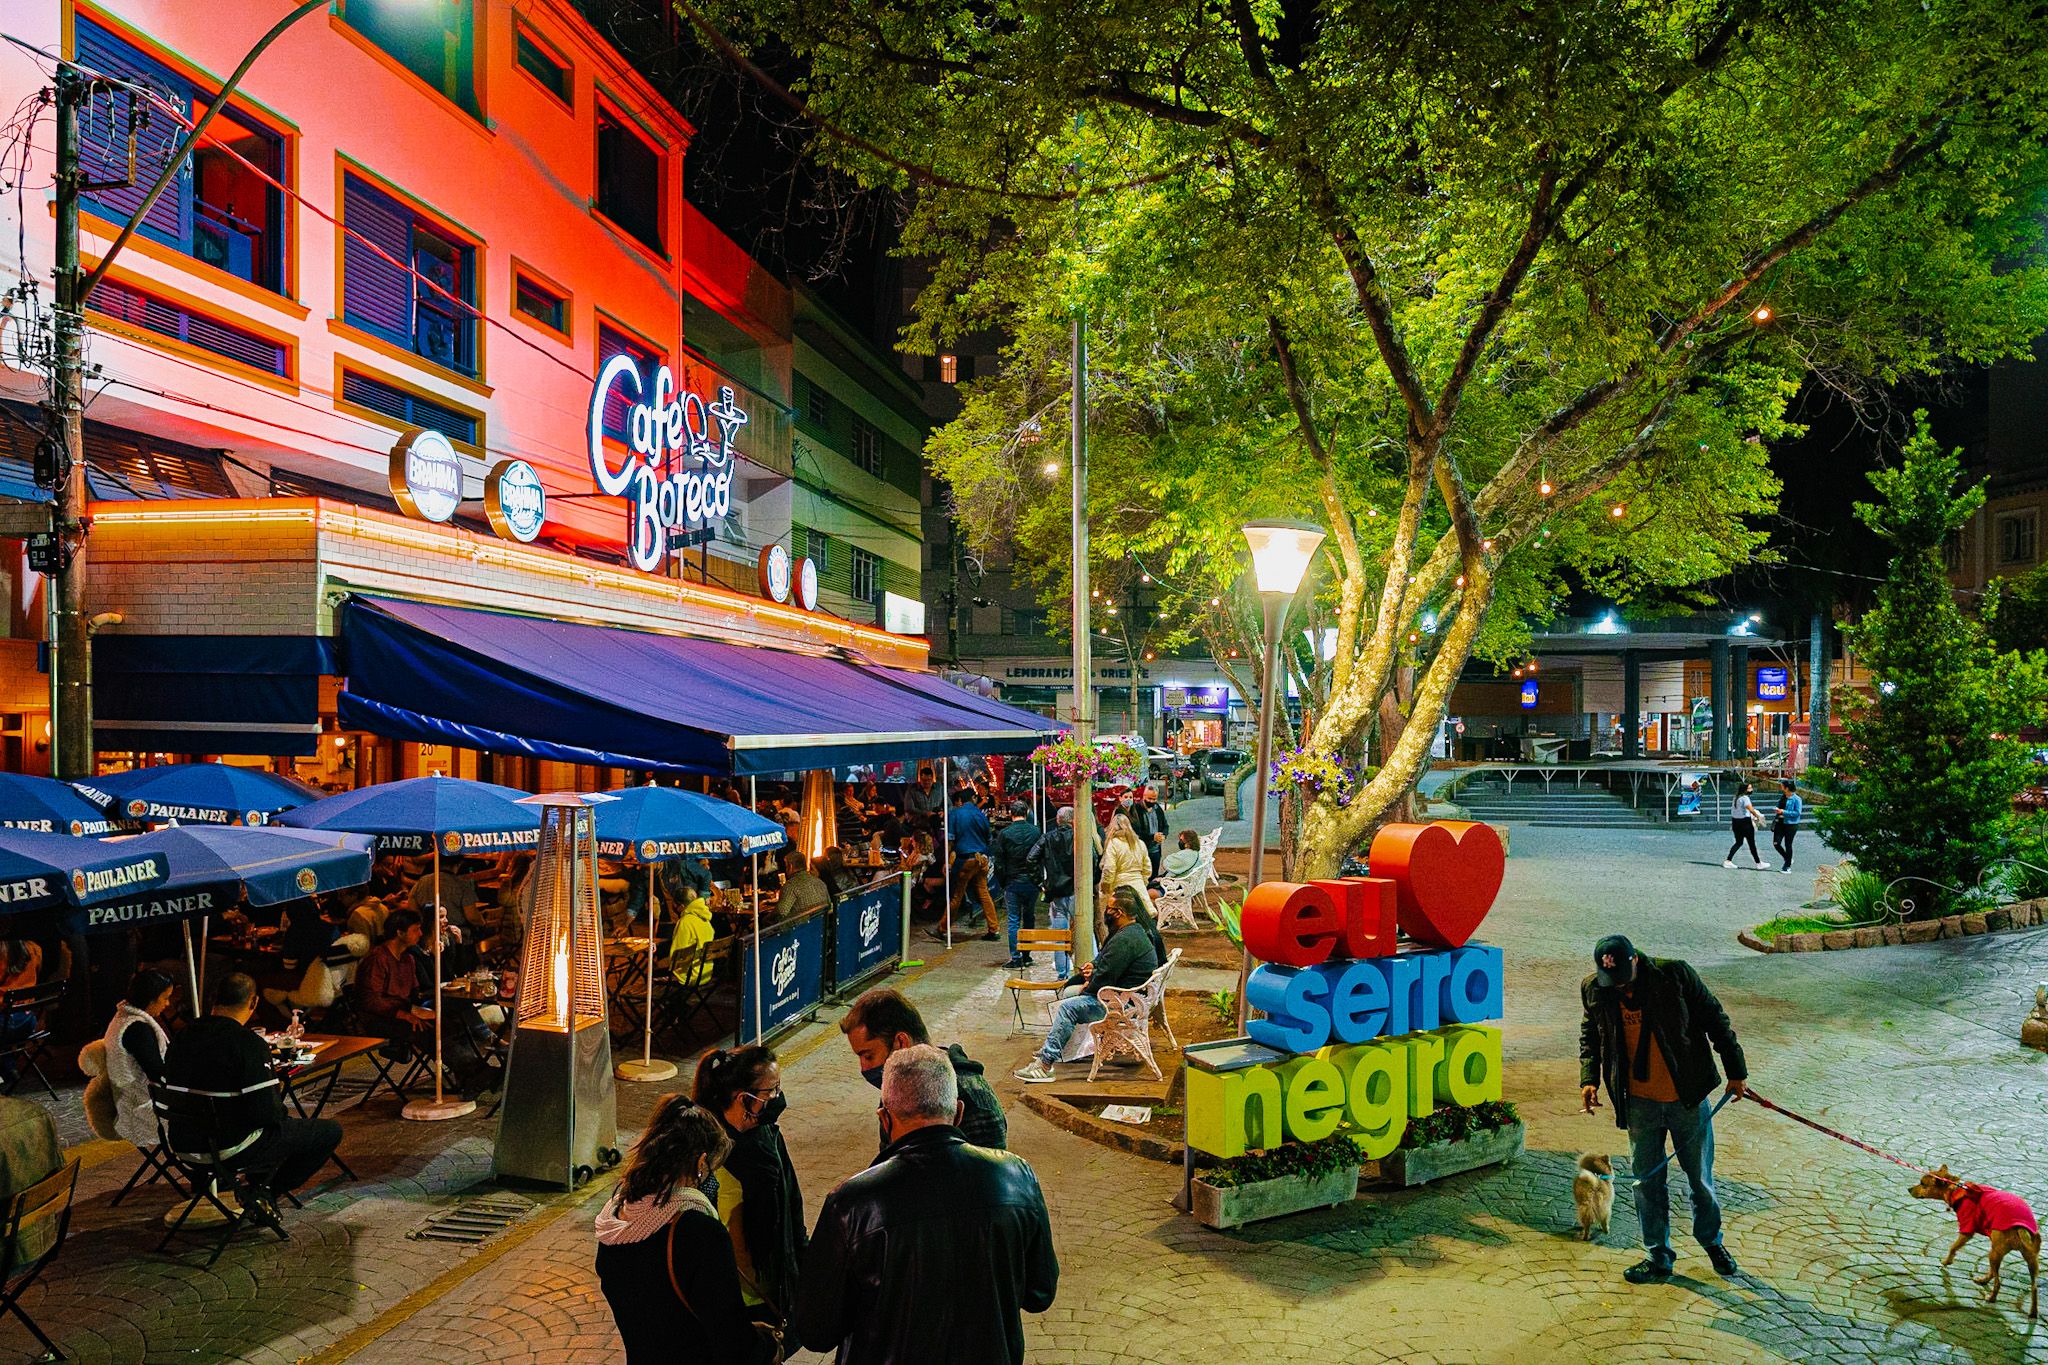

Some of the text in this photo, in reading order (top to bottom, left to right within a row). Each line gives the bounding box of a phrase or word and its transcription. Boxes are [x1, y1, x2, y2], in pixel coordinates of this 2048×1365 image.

[1006, 667, 1074, 679] LEMBRANÇA
[1101, 668, 1149, 679] ORIENE
[1759, 682, 1786, 696] Itaú
[149, 803, 228, 824] PAULANER
[82, 820, 141, 834] PAULANER
[659, 839, 732, 856] PAULANER
[749, 831, 783, 849] PAULANER
[86, 859, 161, 892] PAULANER
[88, 892, 214, 926] PAULANER
[1260, 878, 1398, 967] eu
[1265, 945, 1505, 1054] serra
